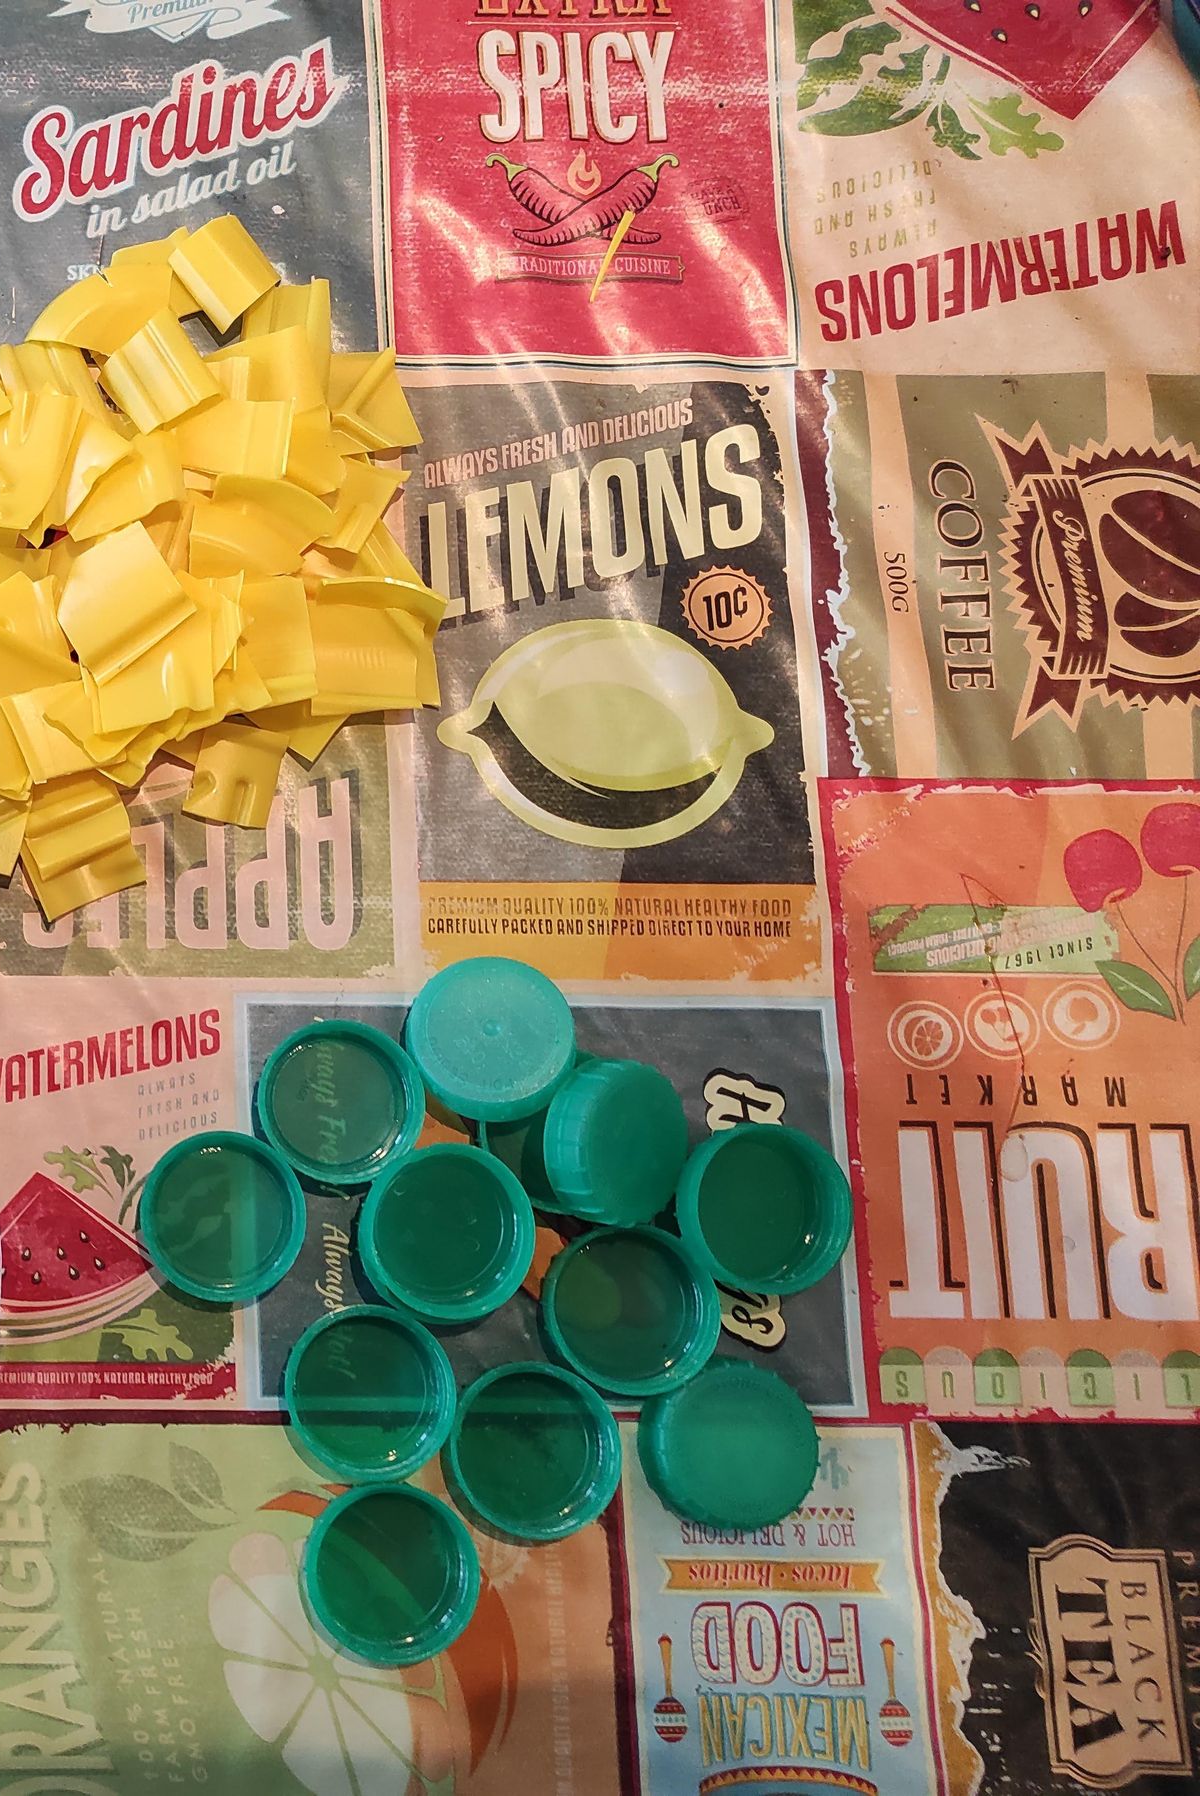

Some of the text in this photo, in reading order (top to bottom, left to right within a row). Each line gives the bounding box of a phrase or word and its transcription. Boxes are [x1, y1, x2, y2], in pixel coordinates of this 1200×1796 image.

[477, 29, 675, 143] SPICY
[15, 39, 346, 219] Sardines
[86, 142, 298, 238] in salad oil
[814, 210, 853, 235] AND
[615, 257, 670, 275] CUISINE
[816, 201, 1186, 342] WATERMELONS
[424, 397, 693, 489] ALWAYS FRESH AND DELICIOUS
[424, 424, 764, 621] LEMONS
[883, 552, 910, 613] 500G
[928, 459, 997, 692] COFFEE
[1052, 510, 1100, 642] Premium
[428, 918, 792, 938] CAREFULLY PACKED AND SHIPPED DIRECT TO YOUR HOME
[502, 897, 564, 916] QUALITY
[569, 897, 609, 916] 100%
[614, 897, 680, 917] NATURAL
[684, 898, 748, 917] HEALTHY
[752, 898, 792, 918] FOOD
[1005, 949, 1042, 970] 1967
[138, 1072, 196, 1096] ALWAYS
[192, 1089, 219, 1106] AND
[905, 1074, 1127, 1108] MARKET
[139, 1111, 217, 1140] DELICIOUS
[315, 1222, 351, 1314] Always
[37, 1372, 75, 1385] QUALITY
[77, 1372, 101, 1385] 100%
[104, 1372, 145, 1385] NATURAL
[147, 1372, 186, 1386] HEALTHY
[791, 1522, 806, 1547] &
[818, 1523, 856, 1546] HOT
[88, 1553, 135, 1684] NATURAL
[690, 1601, 866, 1687] FOOD
[125, 1608, 185, 1783] FARM FRESH
[157, 1639, 189, 1705] FREE
[1055, 1577, 1125, 1755] TEA
[1119, 1580, 1167, 1742] BLACK
[701, 1693, 872, 1771] MEXICAN
